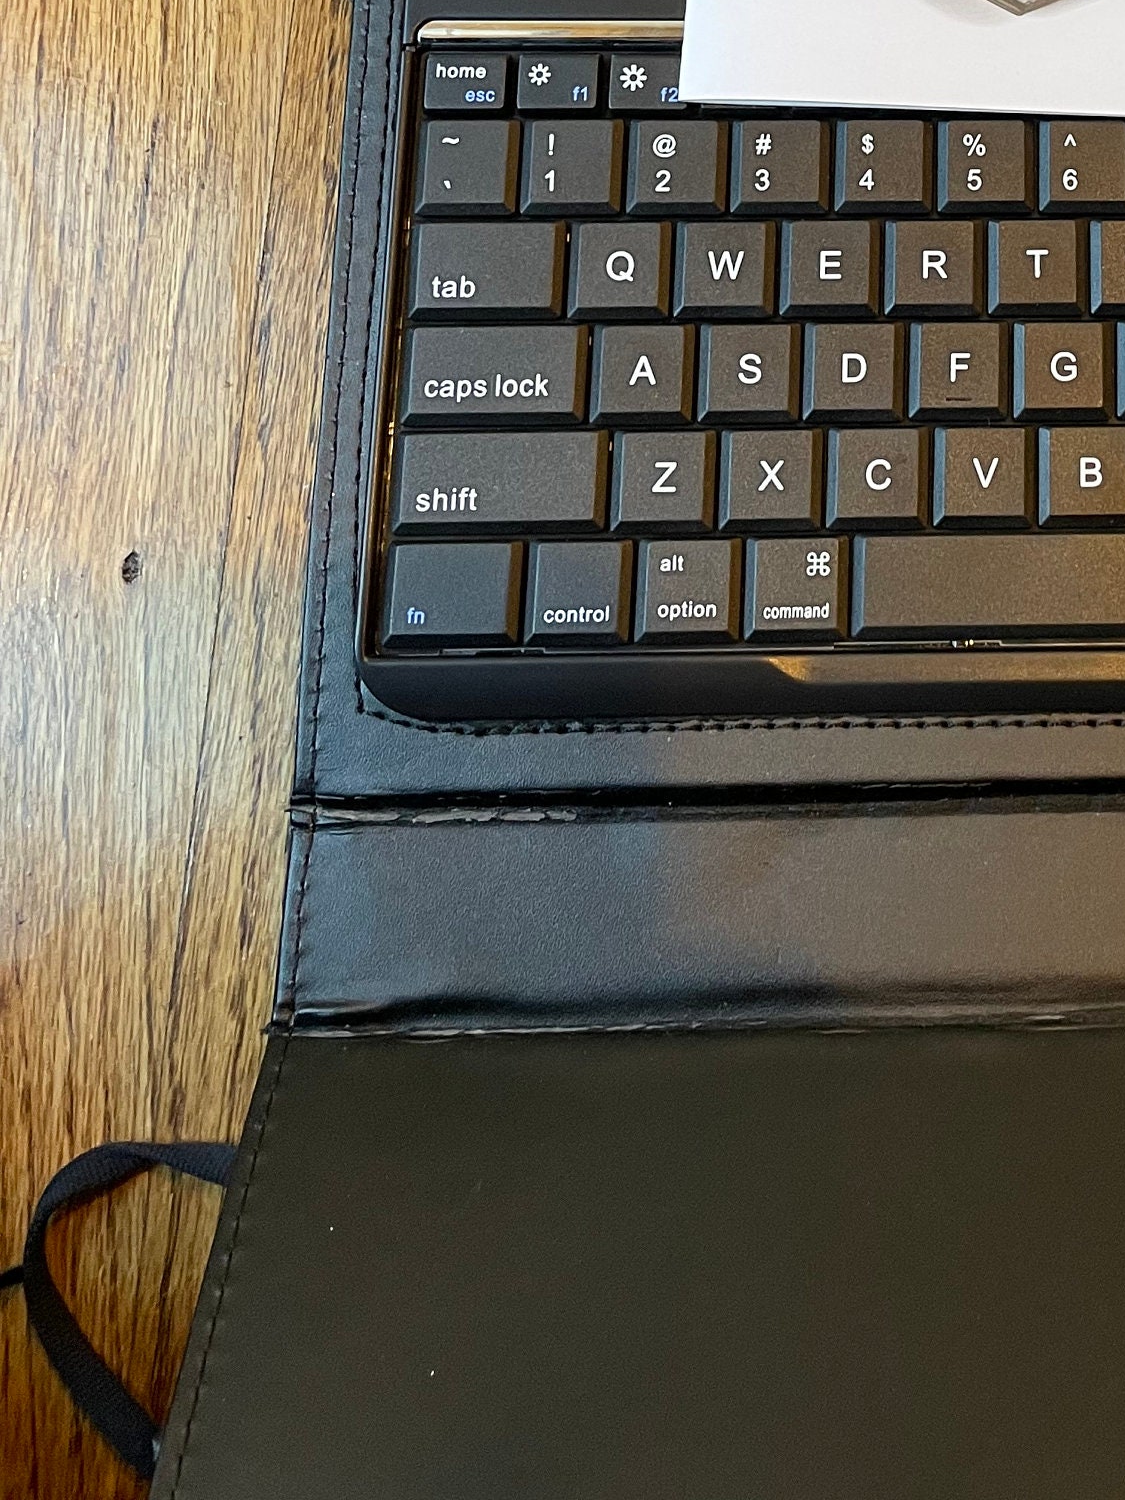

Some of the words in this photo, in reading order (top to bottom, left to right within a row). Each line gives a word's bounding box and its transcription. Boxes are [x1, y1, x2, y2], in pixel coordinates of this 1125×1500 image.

[436, 63, 486, 78] home
[465, 91, 495, 102] esc
[573, 86, 587, 101] f1
[545, 170, 554, 191] 1
[655, 170, 670, 191] 2
[755, 169, 769, 191] 3
[859, 169, 874, 190] 4
[968, 169, 982, 190] 5
[1063, 169, 1077, 190] 6
[606, 251, 634, 281] Q
[708, 251, 744, 279] W
[820, 251, 841, 279] E
[923, 251, 947, 278] R
[1026, 250, 1048, 278] T
[432, 276, 475, 298] tab
[630, 356, 656, 385] A
[738, 354, 761, 384] S
[842, 354, 866, 382] D
[951, 353, 970, 382] F
[1051, 352, 1077, 381] G
[425, 380, 487, 401] caps
[496, 374, 548, 397] lock
[652, 462, 677, 492] Z
[758, 460, 784, 491] X
[866, 459, 891, 490] C
[973, 458, 998, 488] V
[1080, 457, 1102, 487] B
[416, 488, 477, 511] shift
[660, 555, 683, 571] alt
[407, 607, 424, 624] fn
[544, 606, 609, 623] control
[658, 601, 716, 621] option
[764, 603, 829, 619] command
